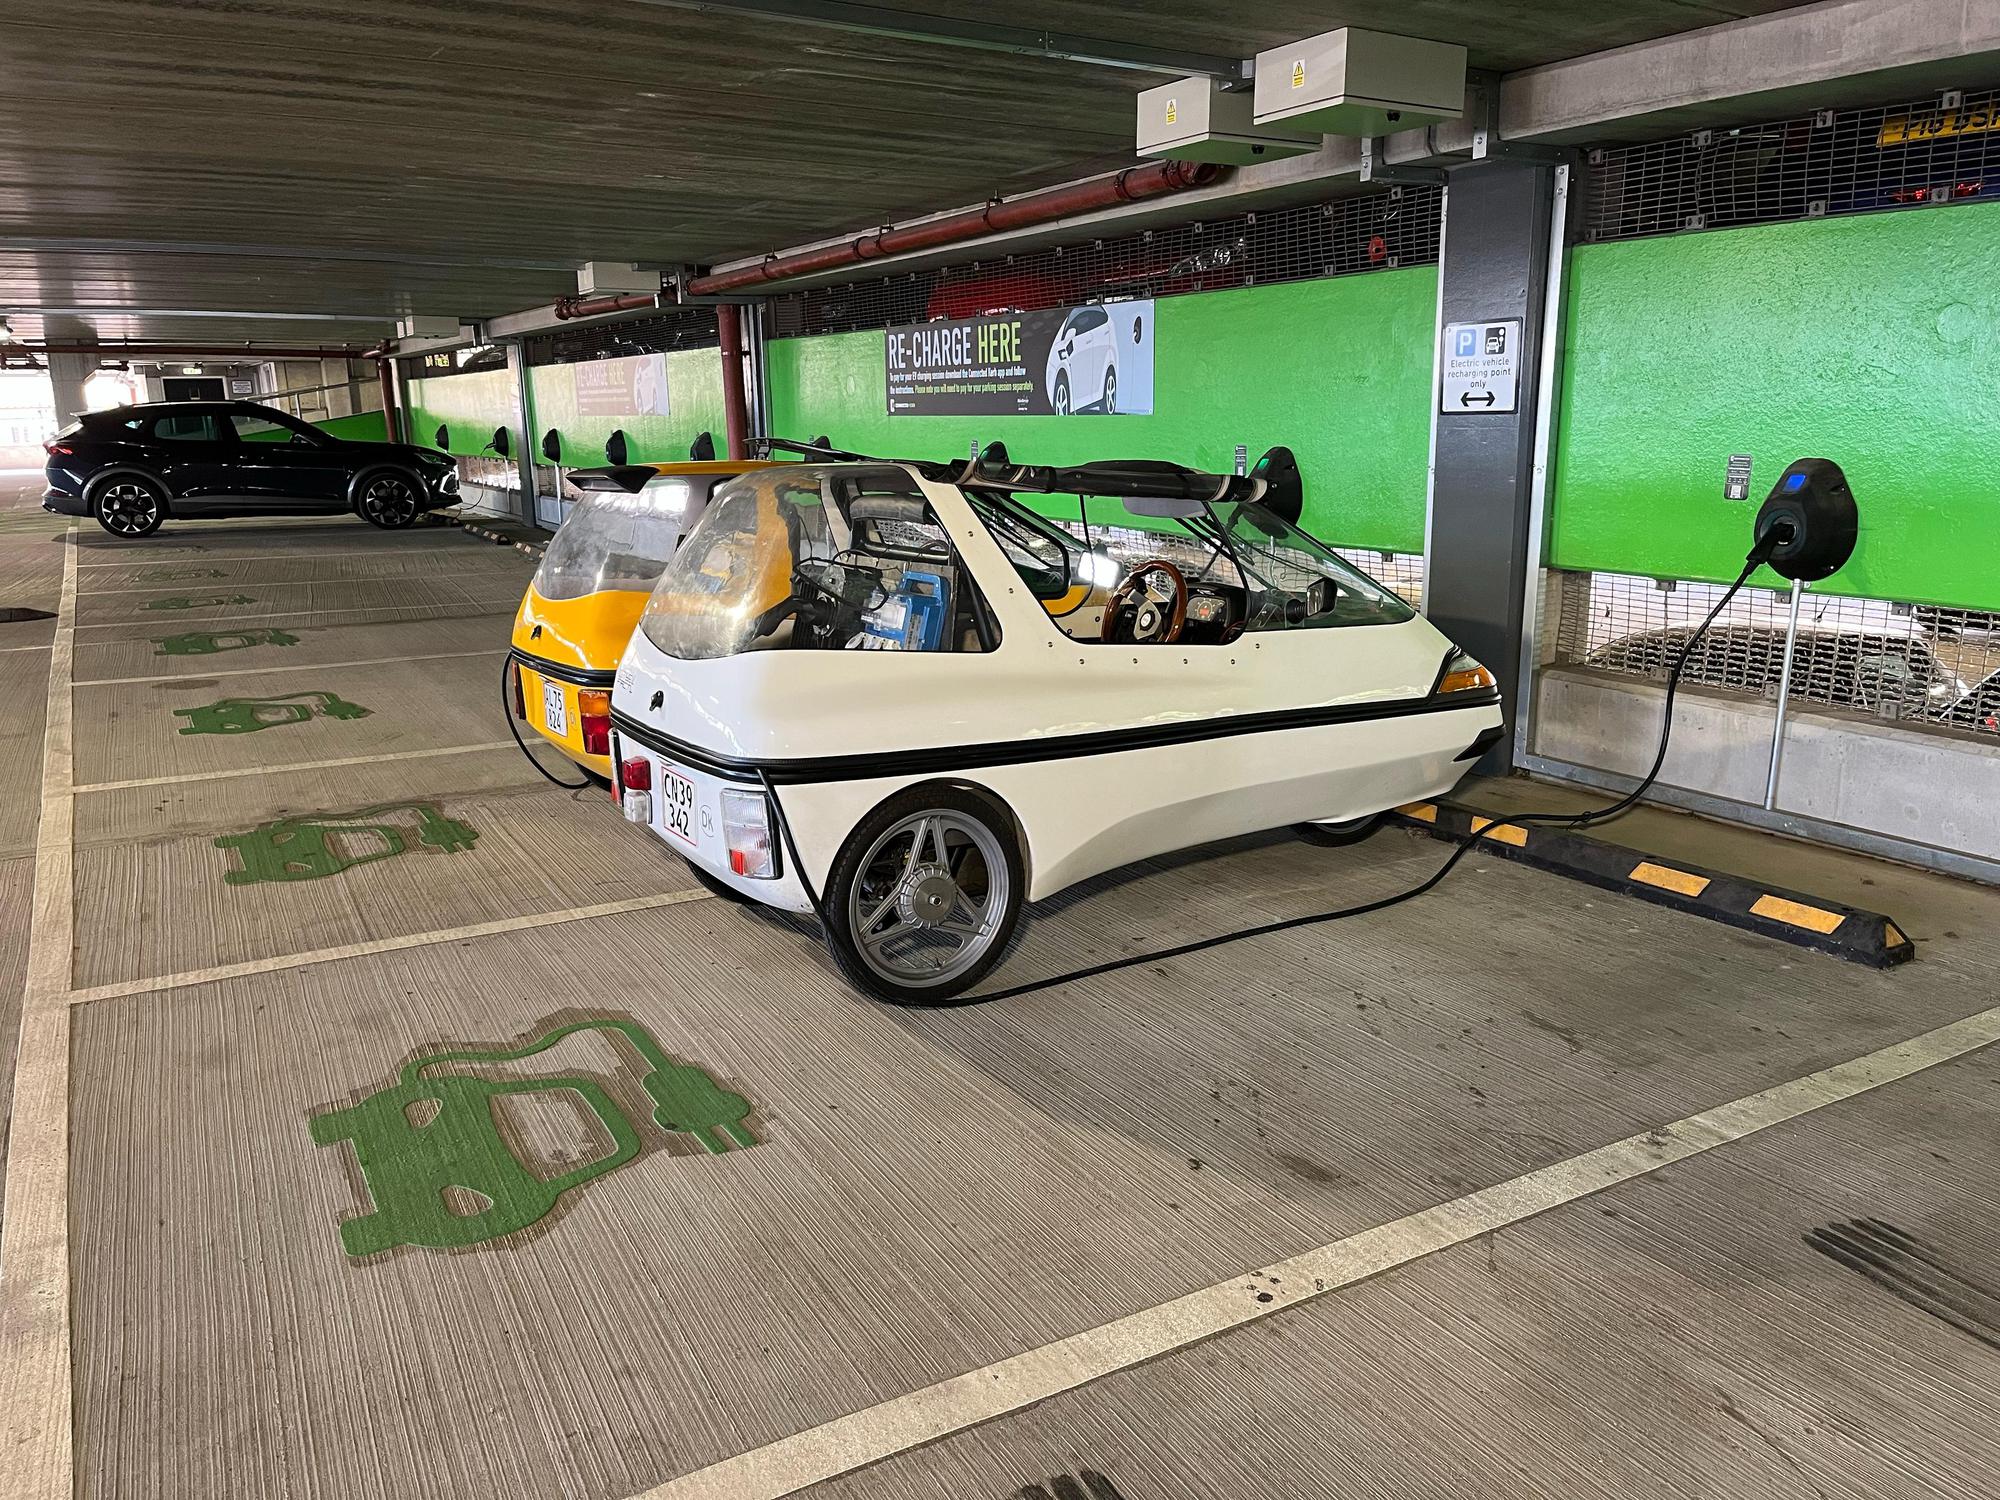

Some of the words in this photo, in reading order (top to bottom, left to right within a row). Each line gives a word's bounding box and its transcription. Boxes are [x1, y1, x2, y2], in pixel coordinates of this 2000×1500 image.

[888, 326, 972, 369] RE-CHARGE
[977, 321, 1021, 364] HERE
[1460, 332, 1472, 355] P
[1448, 369, 1488, 379] recharging
[1490, 368, 1511, 378] point
[1450, 359, 1480, 368] Electric
[1482, 357, 1510, 367] vehicle
[917, 370, 932, 382] charging
[968, 368, 987, 378] Connected
[1470, 380, 1486, 389] only
[982, 382, 997, 394] parking
[997, 381, 1011, 391] session
[545, 687, 562, 711] AL75
[664, 773, 693, 809] CN39
[669, 803, 690, 837] 342
[701, 810, 714, 833] DK
